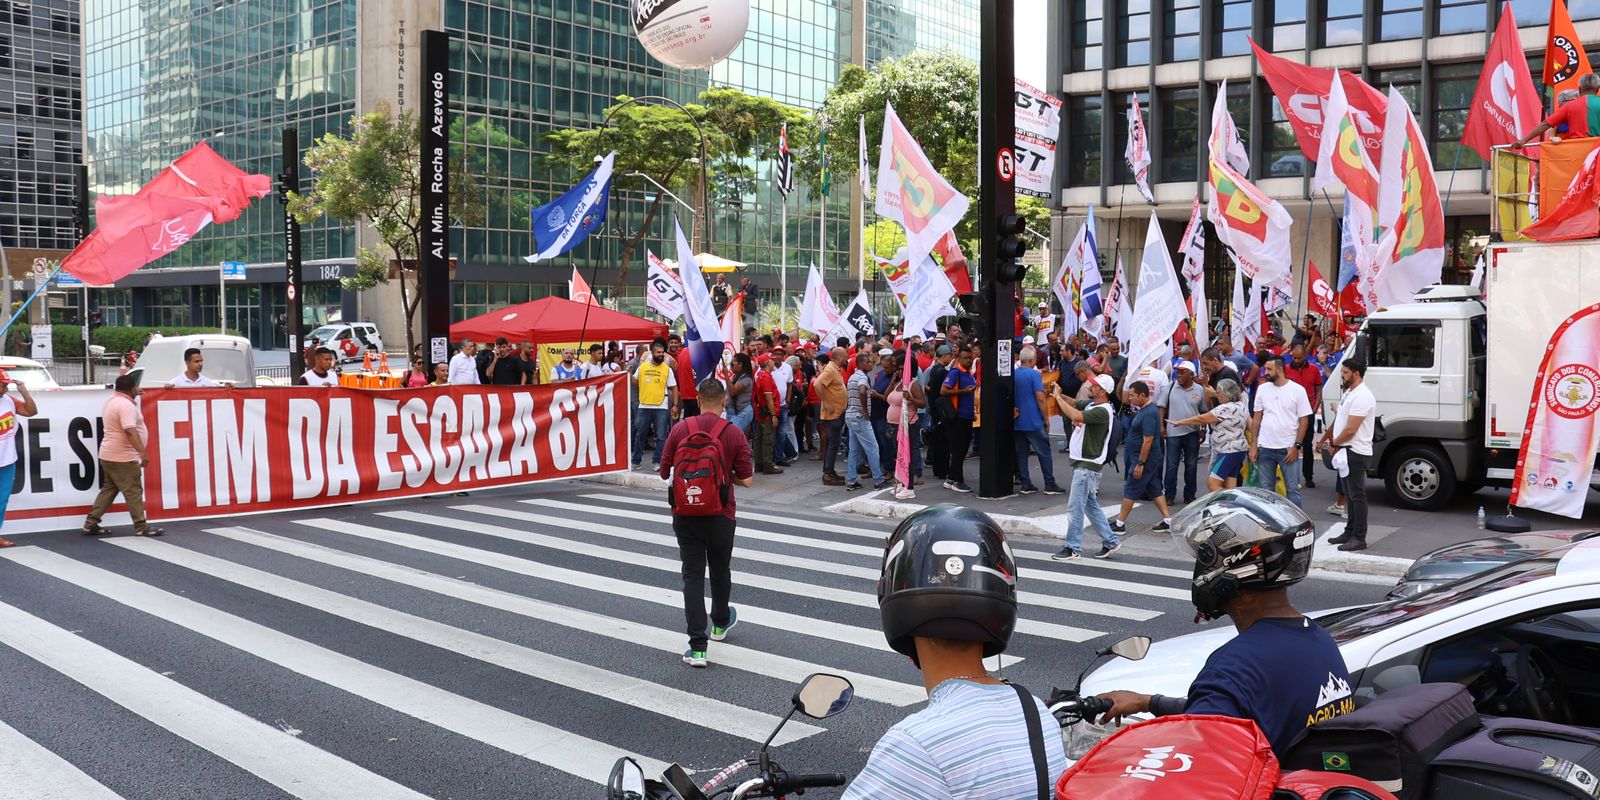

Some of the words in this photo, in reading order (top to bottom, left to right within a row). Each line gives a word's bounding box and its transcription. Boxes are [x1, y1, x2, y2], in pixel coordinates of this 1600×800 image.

[432, 72, 444, 137] Azevedo
[1015, 91, 1052, 116] GT
[432, 147, 444, 194] Rocha
[1015, 145, 1046, 172] GT
[432, 203, 444, 234] Min.
[432, 239, 444, 259] Al.
[320, 265, 340, 280] 1842
[1561, 366, 1576, 375] DOS
[157, 397, 271, 510] FIM
[288, 396, 363, 500] DA
[373, 391, 537, 492] ESCALA
[548, 382, 617, 472] 6X1
